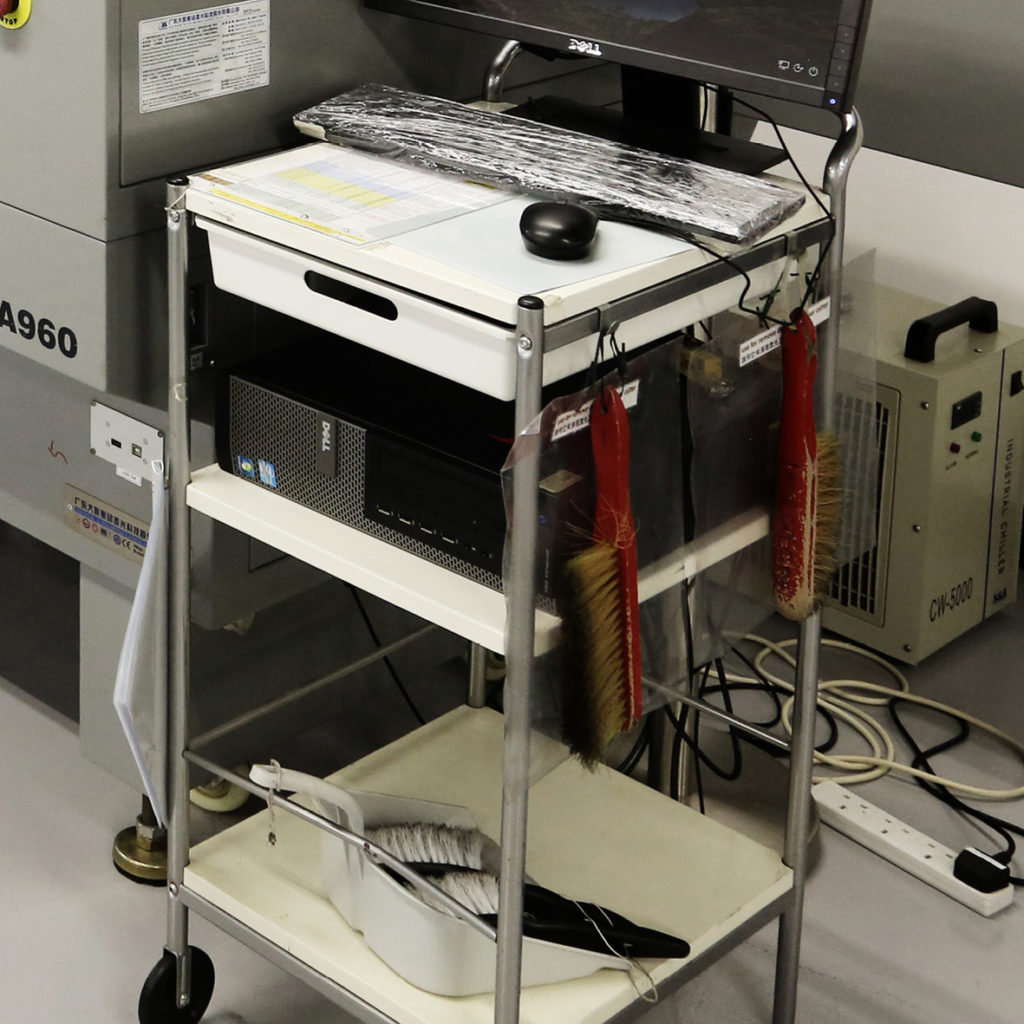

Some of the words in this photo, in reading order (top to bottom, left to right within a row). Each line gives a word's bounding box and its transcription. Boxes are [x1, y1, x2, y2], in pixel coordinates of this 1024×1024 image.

[568, 38, 602, 56] DELL
[321, 420, 331, 452] DELL
[1002, 438, 1015, 515] INDUSTRIAL
[997, 521, 1009, 576] CHILLER
[929, 577, 974, 622] CW-5000
